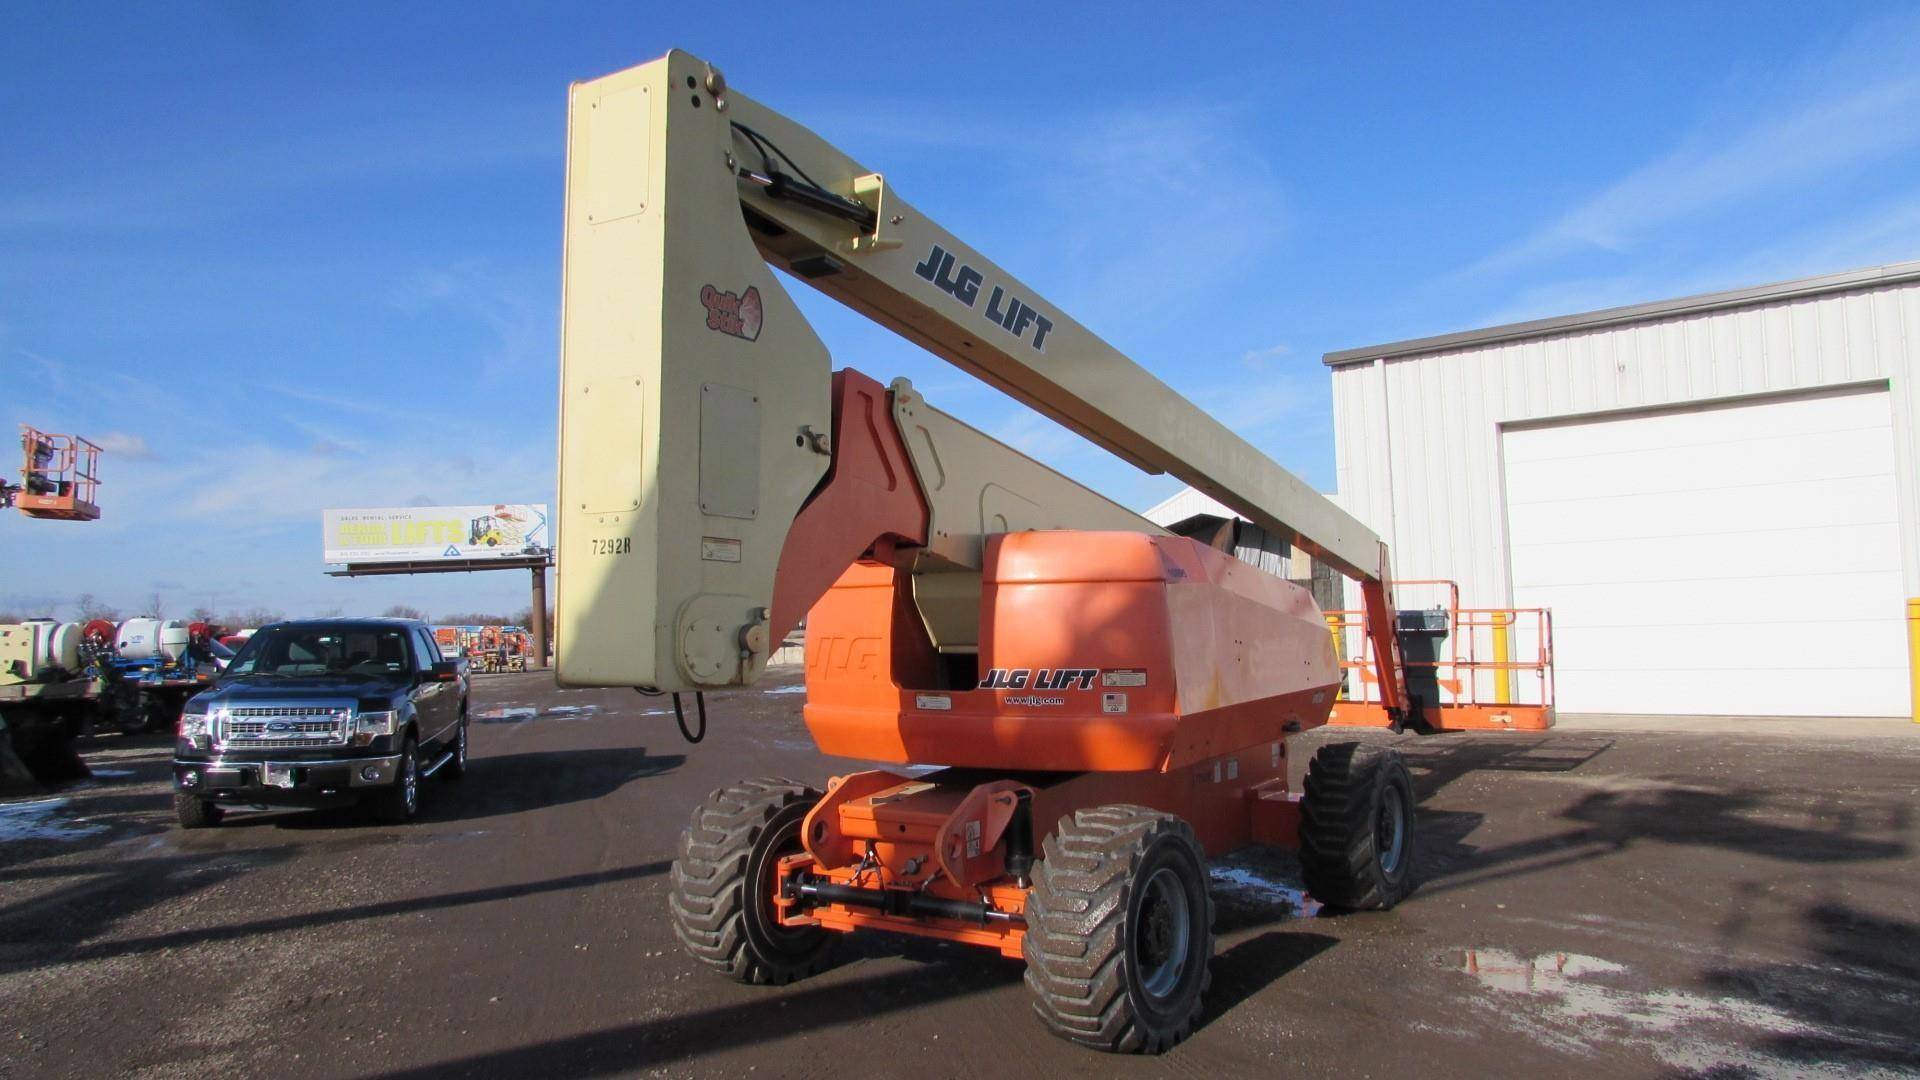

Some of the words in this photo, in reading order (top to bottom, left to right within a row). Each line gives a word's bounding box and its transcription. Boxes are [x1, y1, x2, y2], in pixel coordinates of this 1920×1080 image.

[914, 243, 984, 309] JLG
[984, 286, 1055, 352] LIFT
[391, 518, 465, 545] LIFTS
[592, 536, 631, 555] 7292R
[979, 668, 1032, 690] JLG
[1032, 668, 1100, 690] LIFT
[1005, 695, 1064, 707] www.jlg.com
